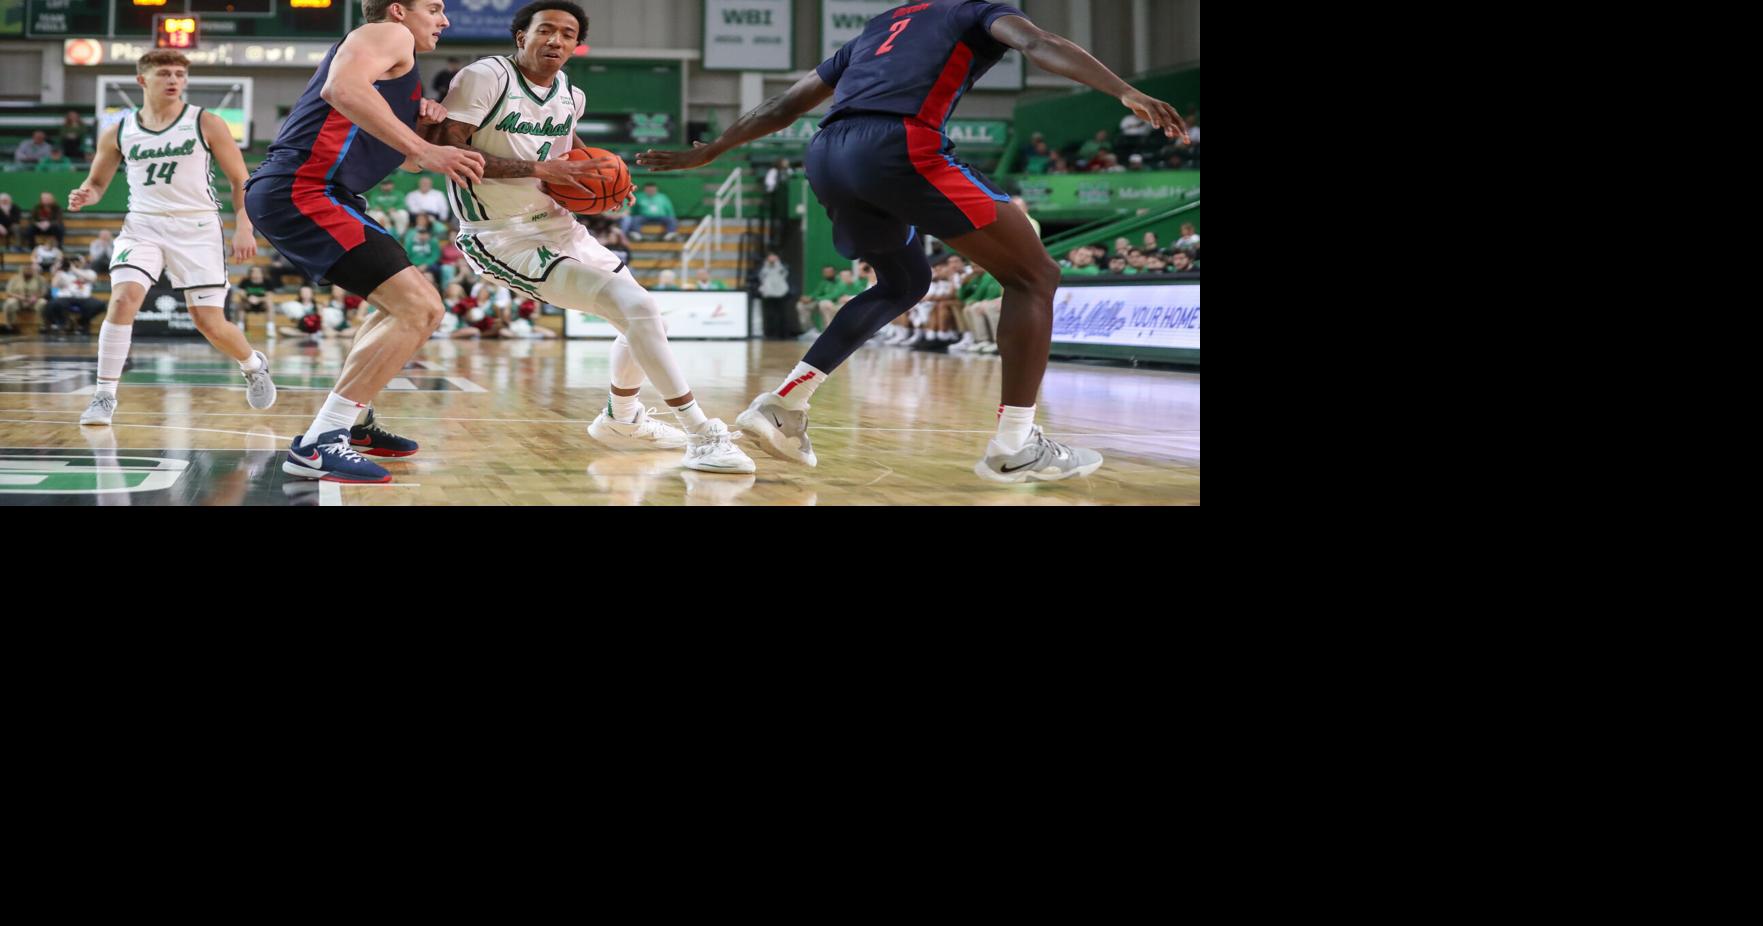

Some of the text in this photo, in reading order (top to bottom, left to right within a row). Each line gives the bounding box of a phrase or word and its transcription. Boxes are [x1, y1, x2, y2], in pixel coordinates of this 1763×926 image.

[721, 8, 773, 25] WBI
[874, 17, 912, 57] 2
[495, 111, 573, 136] Marshal
[128, 138, 196, 161] Marshall
[536, 141, 552, 162] 1
[143, 161, 178, 186] 14
[1129, 306, 1164, 327] YOUR
[1163, 306, 1199, 329] HOME
